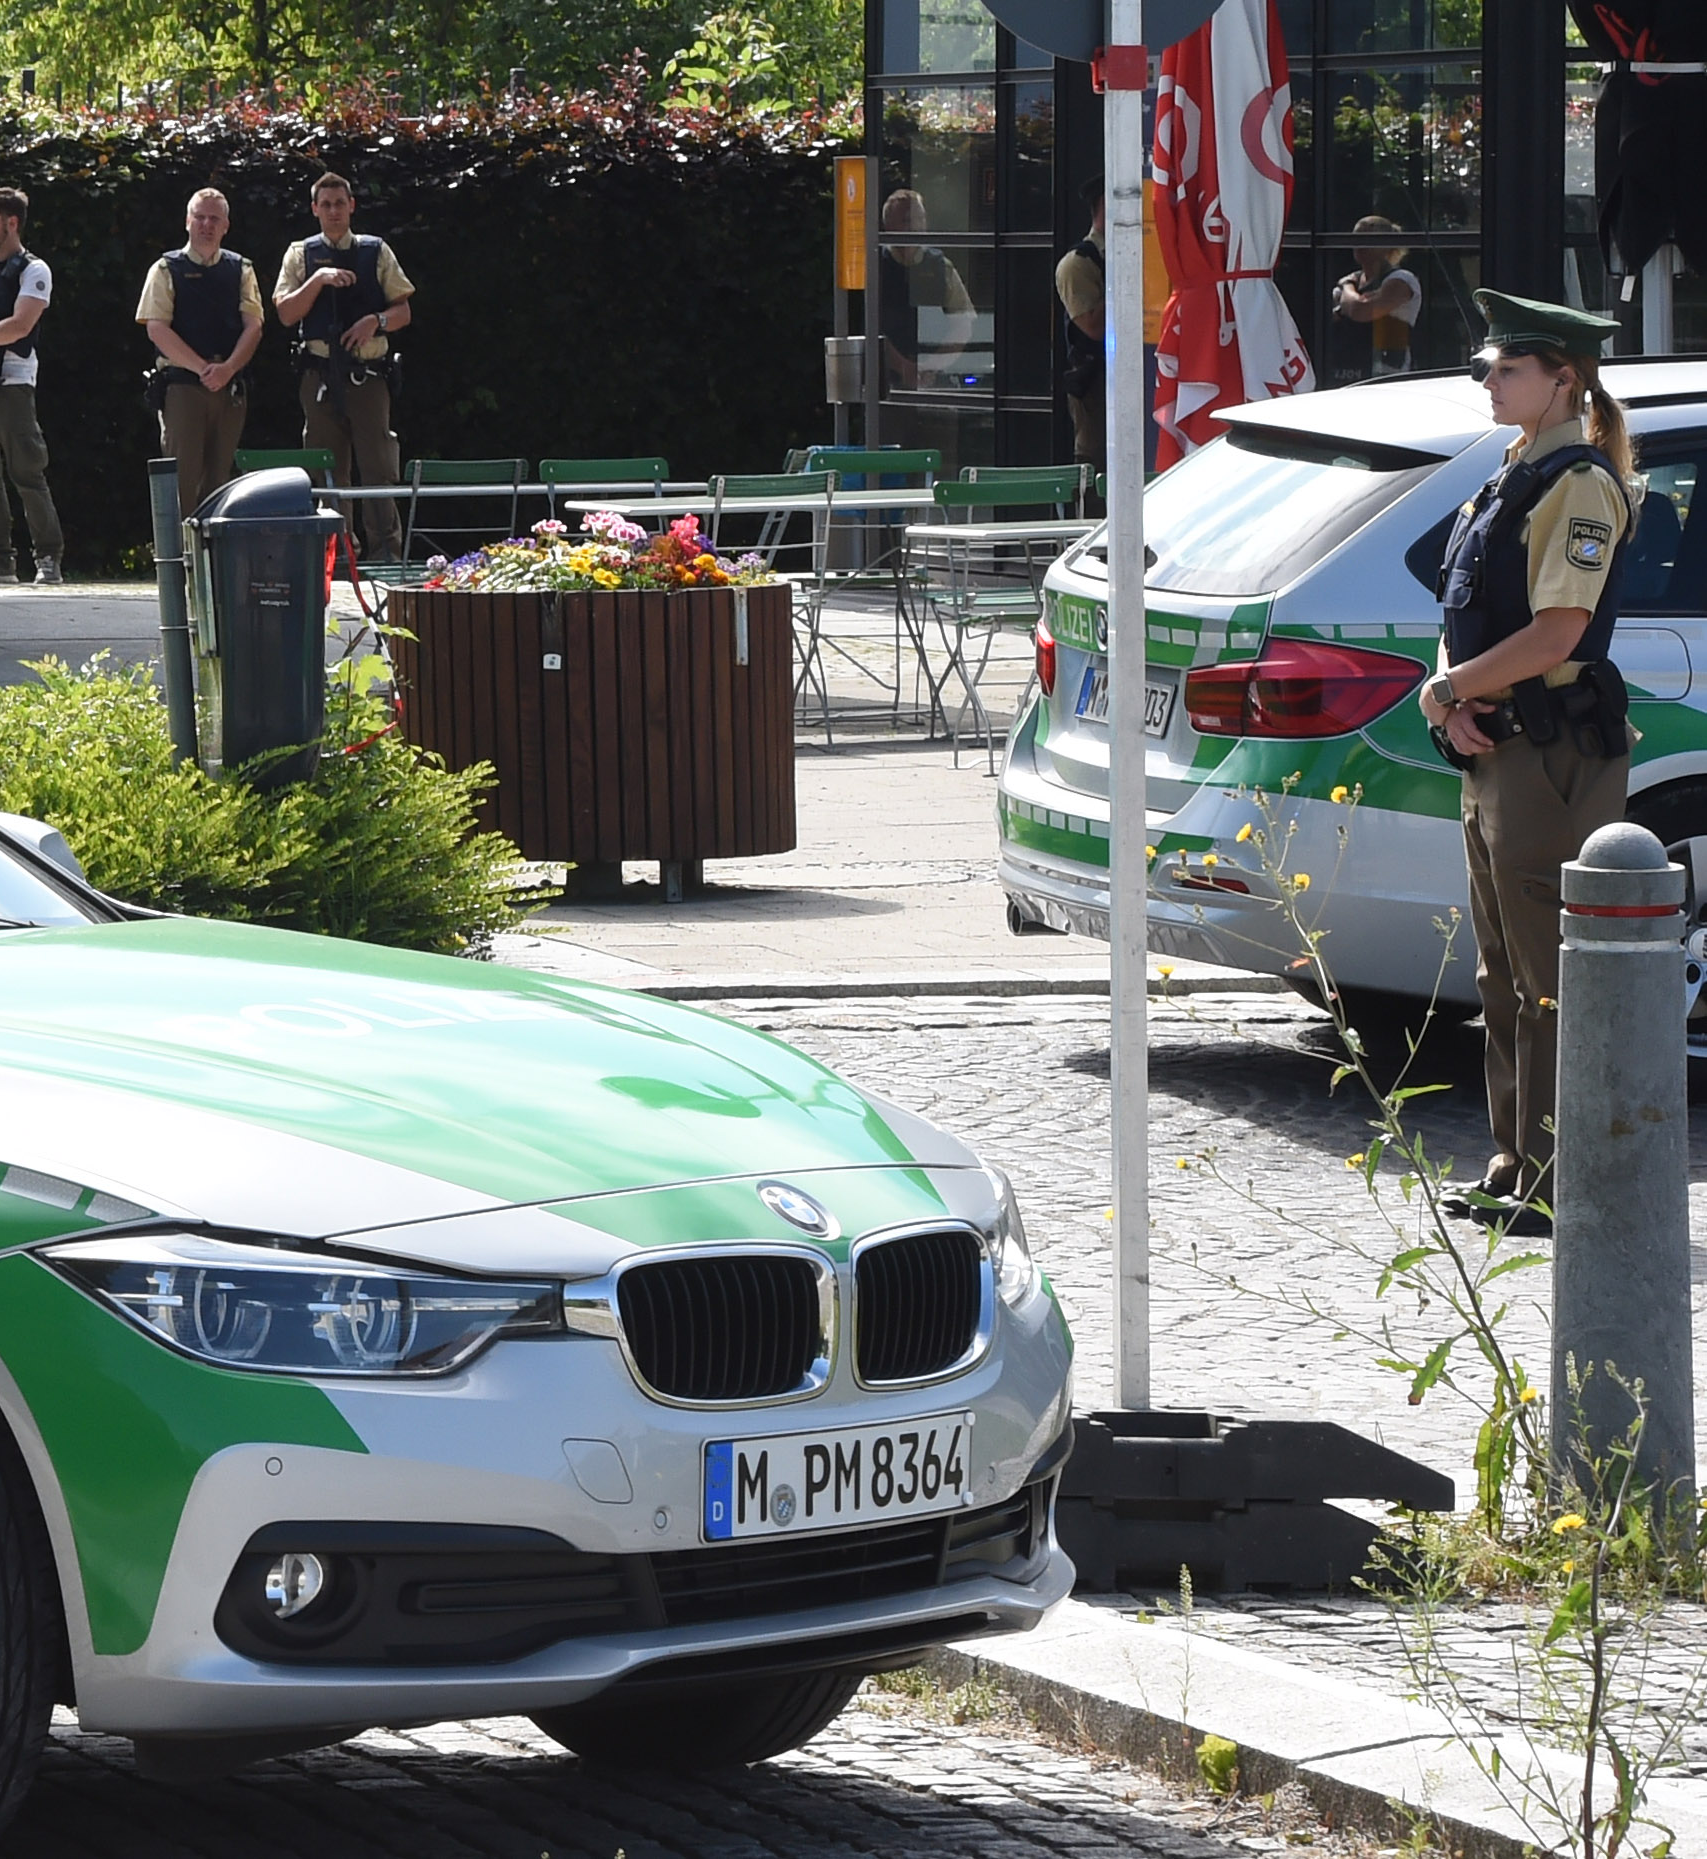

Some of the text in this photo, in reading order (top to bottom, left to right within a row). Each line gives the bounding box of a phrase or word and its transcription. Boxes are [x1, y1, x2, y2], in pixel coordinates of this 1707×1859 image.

[1145, 687, 1168, 728] 03
[737, 1425, 963, 1524] M PM 8364
[712, 1500, 724, 1522] D
